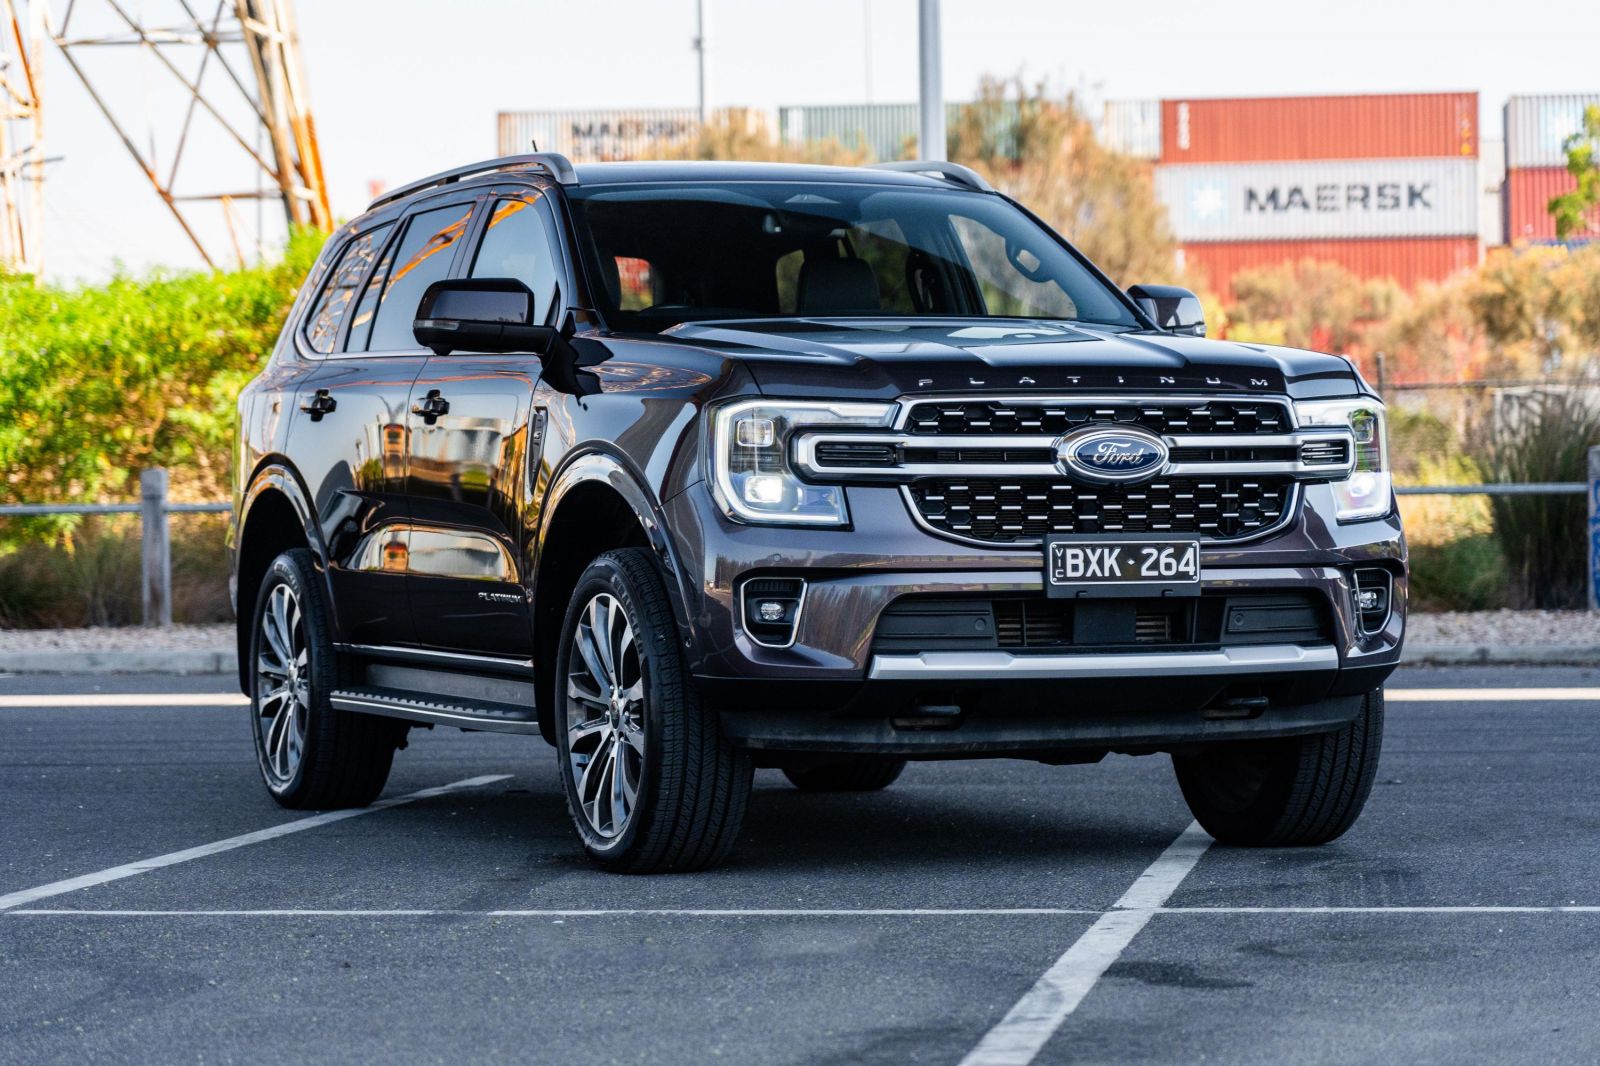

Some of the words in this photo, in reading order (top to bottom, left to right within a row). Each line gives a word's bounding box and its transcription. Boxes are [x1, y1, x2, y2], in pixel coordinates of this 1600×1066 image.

[1244, 182, 1433, 213] MAERSK
[918, 376, 1269, 387] PLATINUM
[1093, 442, 1144, 466] Ford
[1055, 548, 1064, 578] VIC
[1066, 547, 1122, 577] BXK
[1141, 547, 1196, 577] 264
